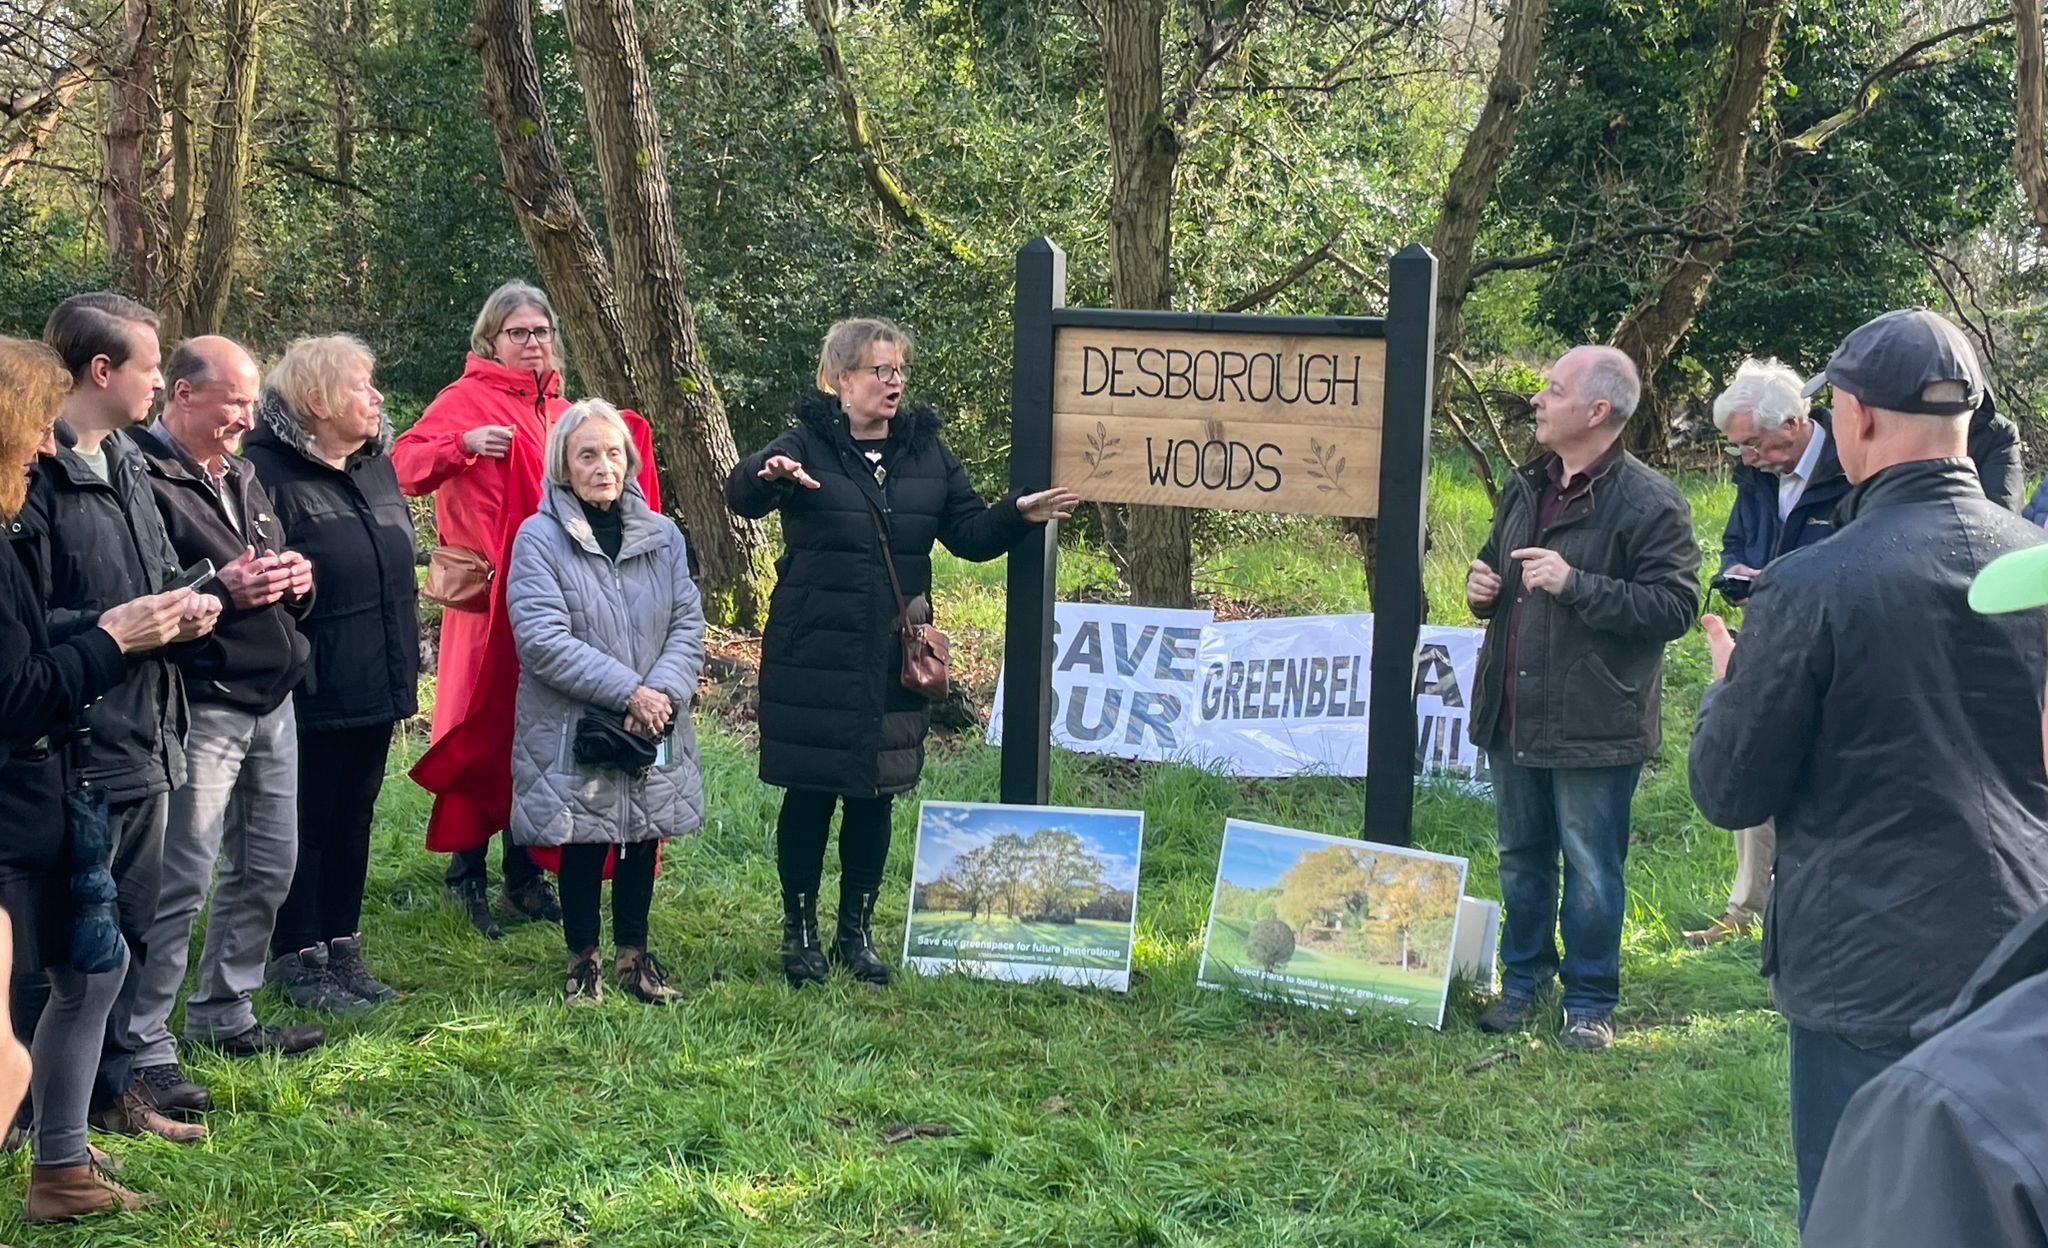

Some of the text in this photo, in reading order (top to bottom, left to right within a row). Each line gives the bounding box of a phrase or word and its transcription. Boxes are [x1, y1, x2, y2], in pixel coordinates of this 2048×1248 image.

[1081, 346, 1361, 405] DESBOROUGH
[1146, 437, 1283, 492] WOODS
[1052, 620, 1200, 681] AVE
[1050, 685, 1182, 749] UR
[1202, 655, 1370, 721] GREENBEL
[917, 935, 940, 946] Save
[942, 938, 958, 947] our
[960, 940, 1015, 951] greenspace
[1016, 941, 1030, 951] for
[1032, 942, 1061, 954] future
[1063, 946, 1121, 958] generations
[1233, 964, 1259, 977] Reject
[1261, 971, 1284, 982] plans
[1286, 975, 1295, 984] to
[1296, 977, 1318, 988] build
[1340, 985, 1356, 995] our
